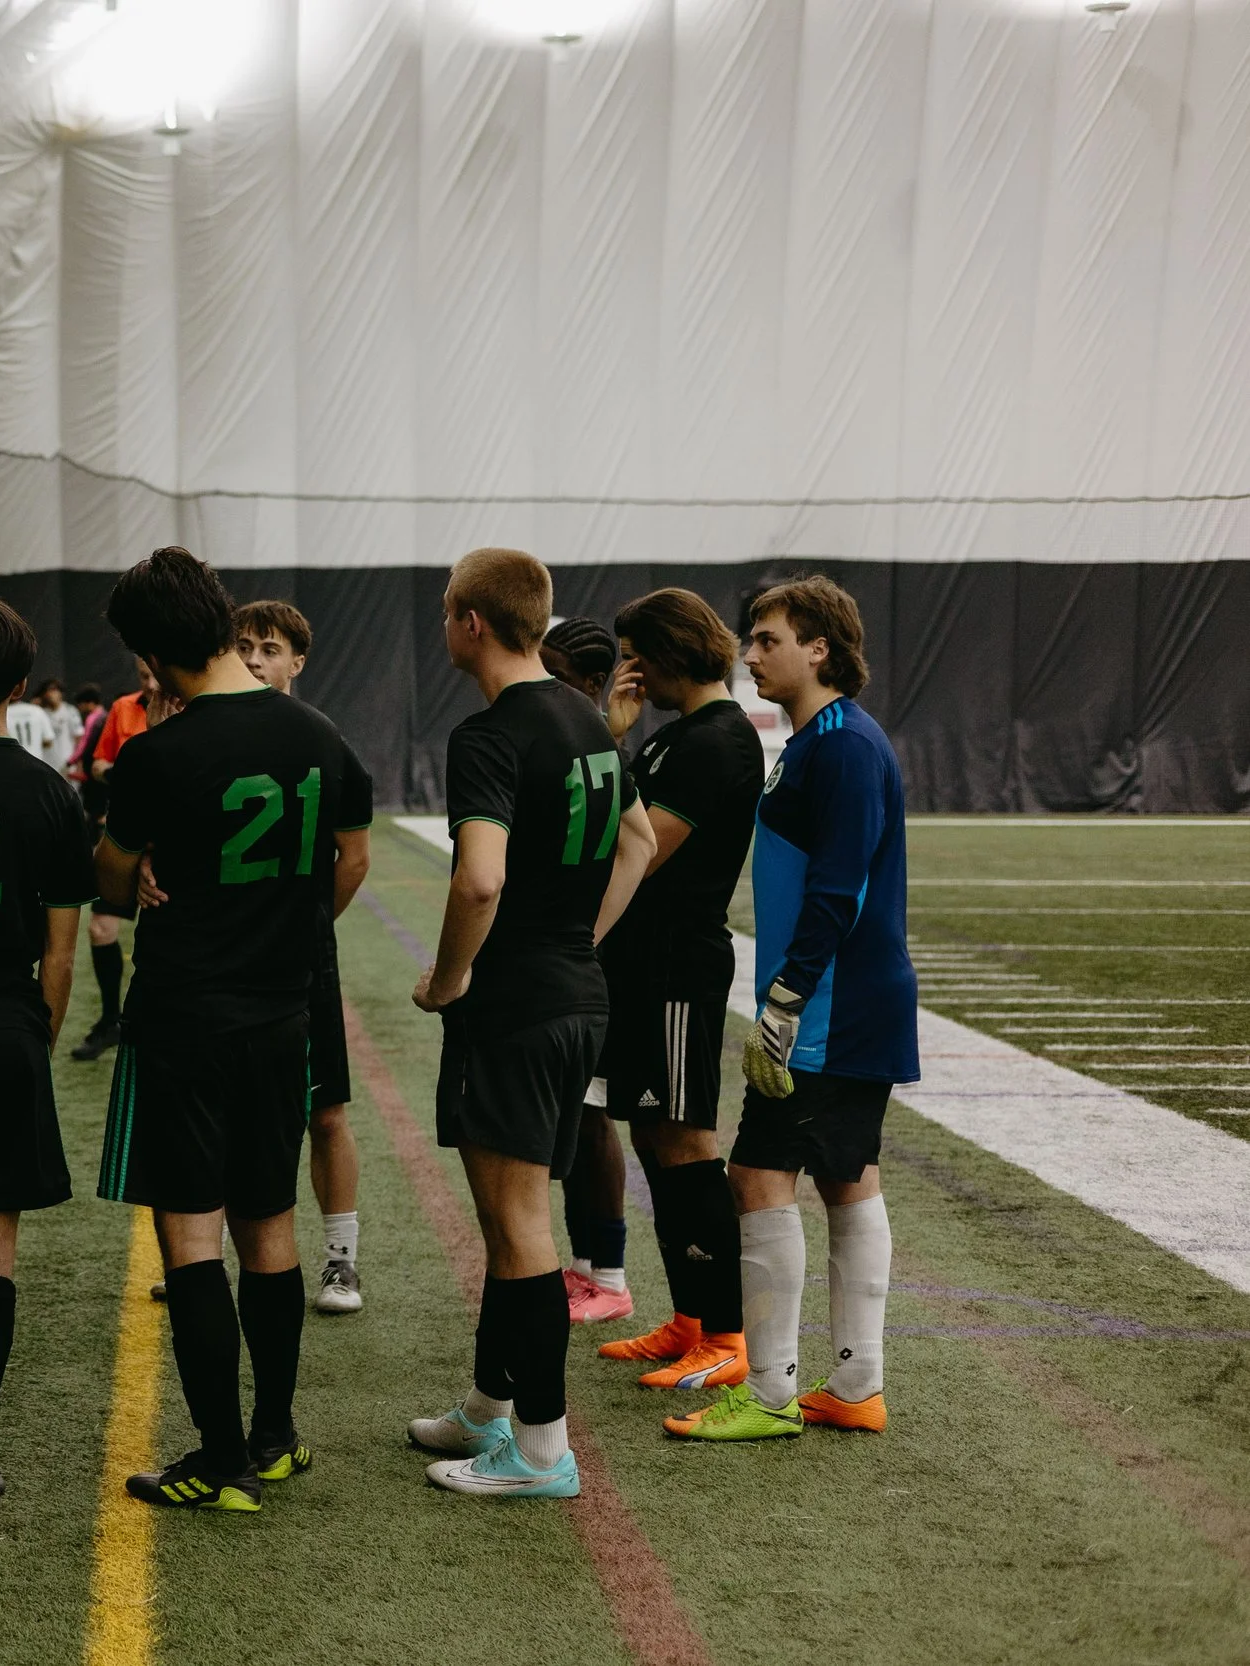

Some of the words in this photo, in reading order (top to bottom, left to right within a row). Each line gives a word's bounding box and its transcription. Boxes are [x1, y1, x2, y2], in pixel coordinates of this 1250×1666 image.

[220, 767, 322, 885] 21
[561, 751, 622, 866] 17
[637, 1099, 661, 1107] adidas
